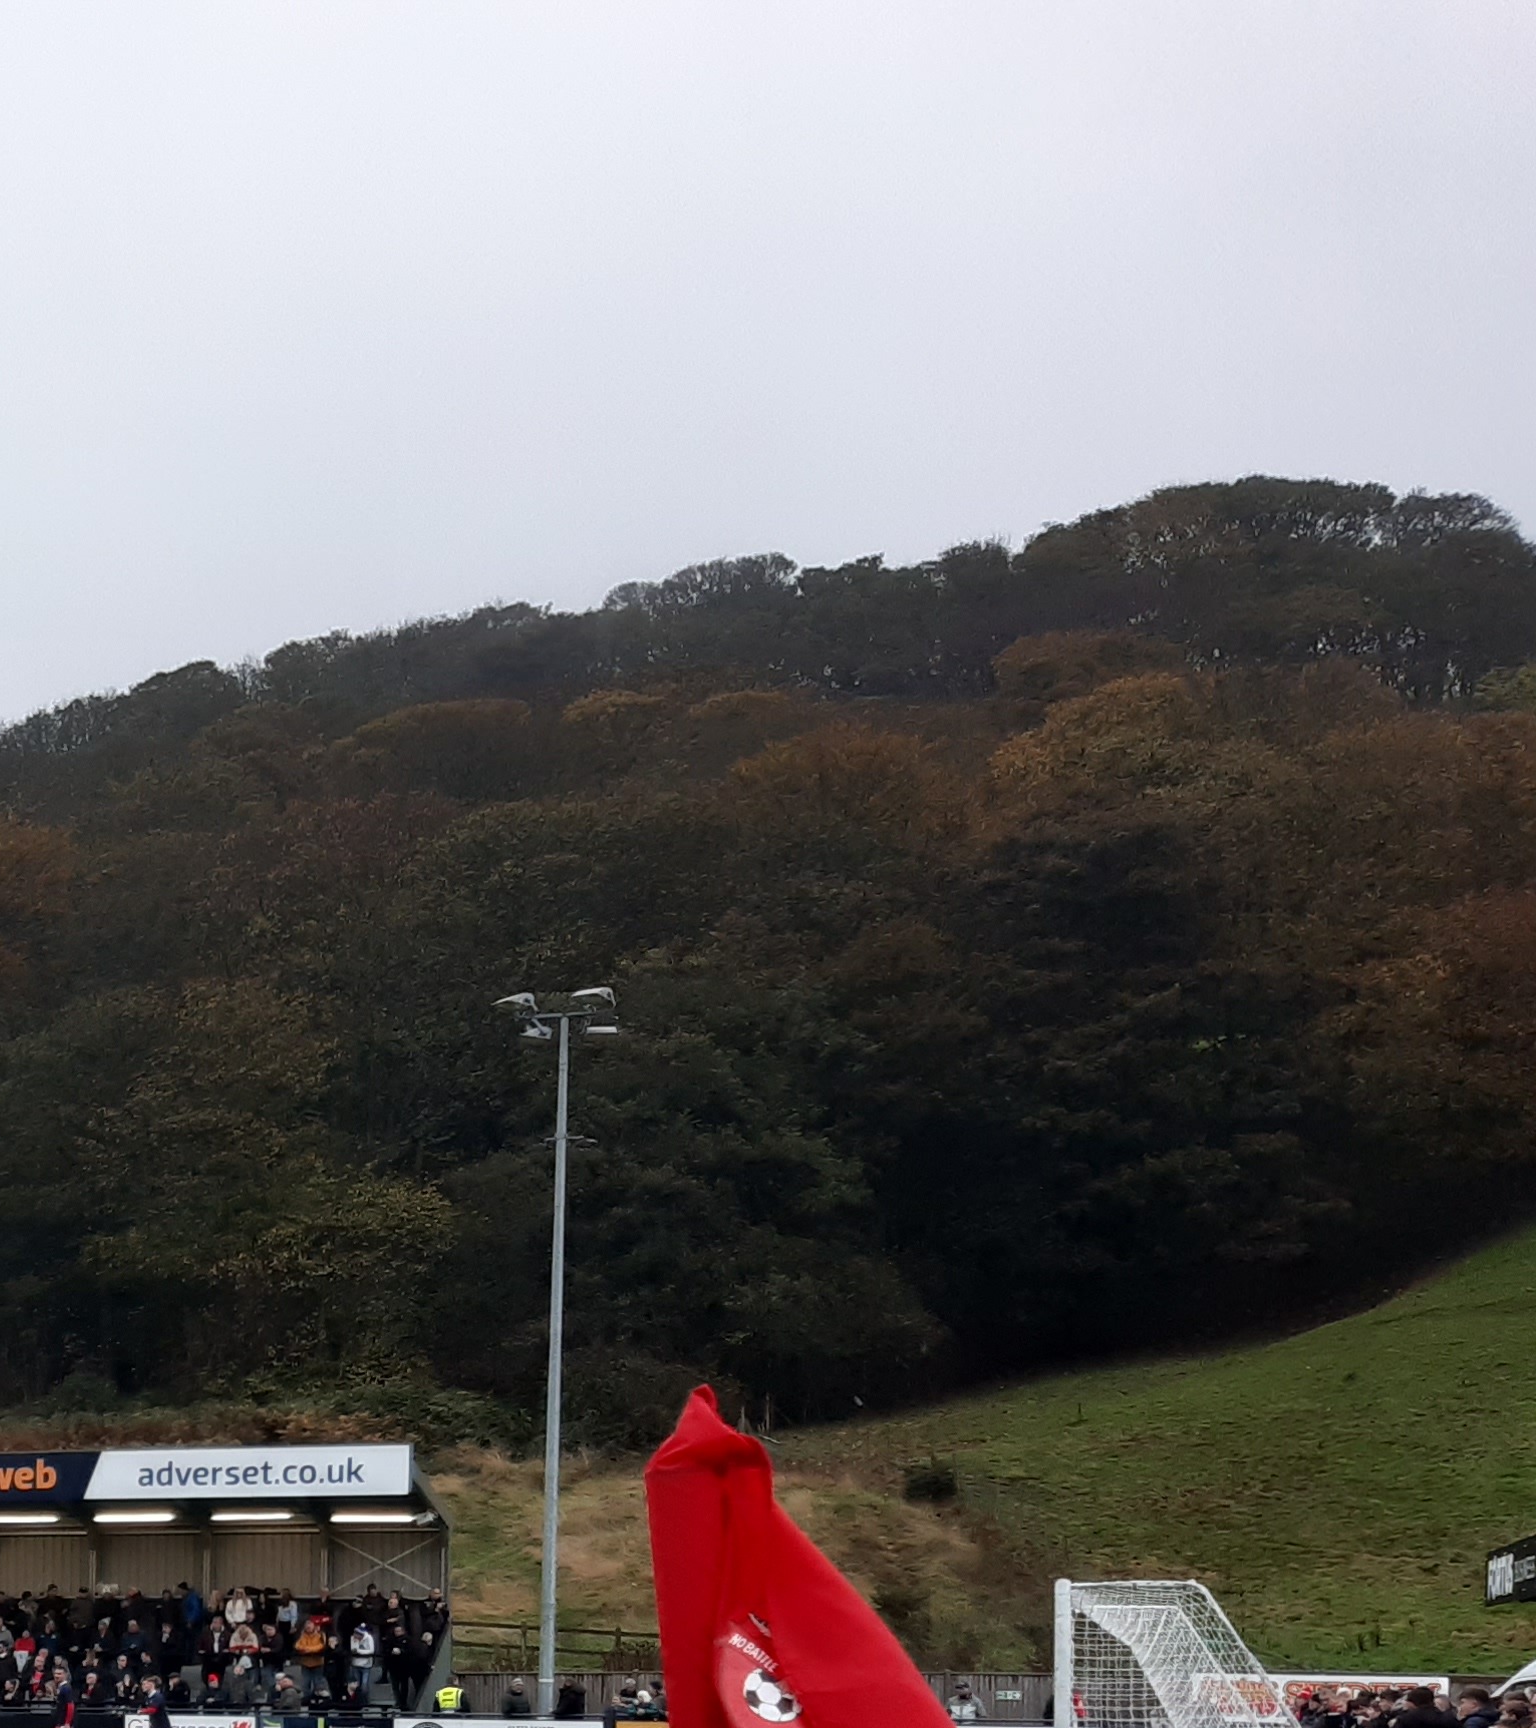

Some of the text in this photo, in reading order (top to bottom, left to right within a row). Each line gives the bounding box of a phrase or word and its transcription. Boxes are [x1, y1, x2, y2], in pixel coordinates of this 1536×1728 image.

[137, 1456, 366, 1487] adverset.co.uk
[729, 1633, 779, 1673] NO BATTLE
